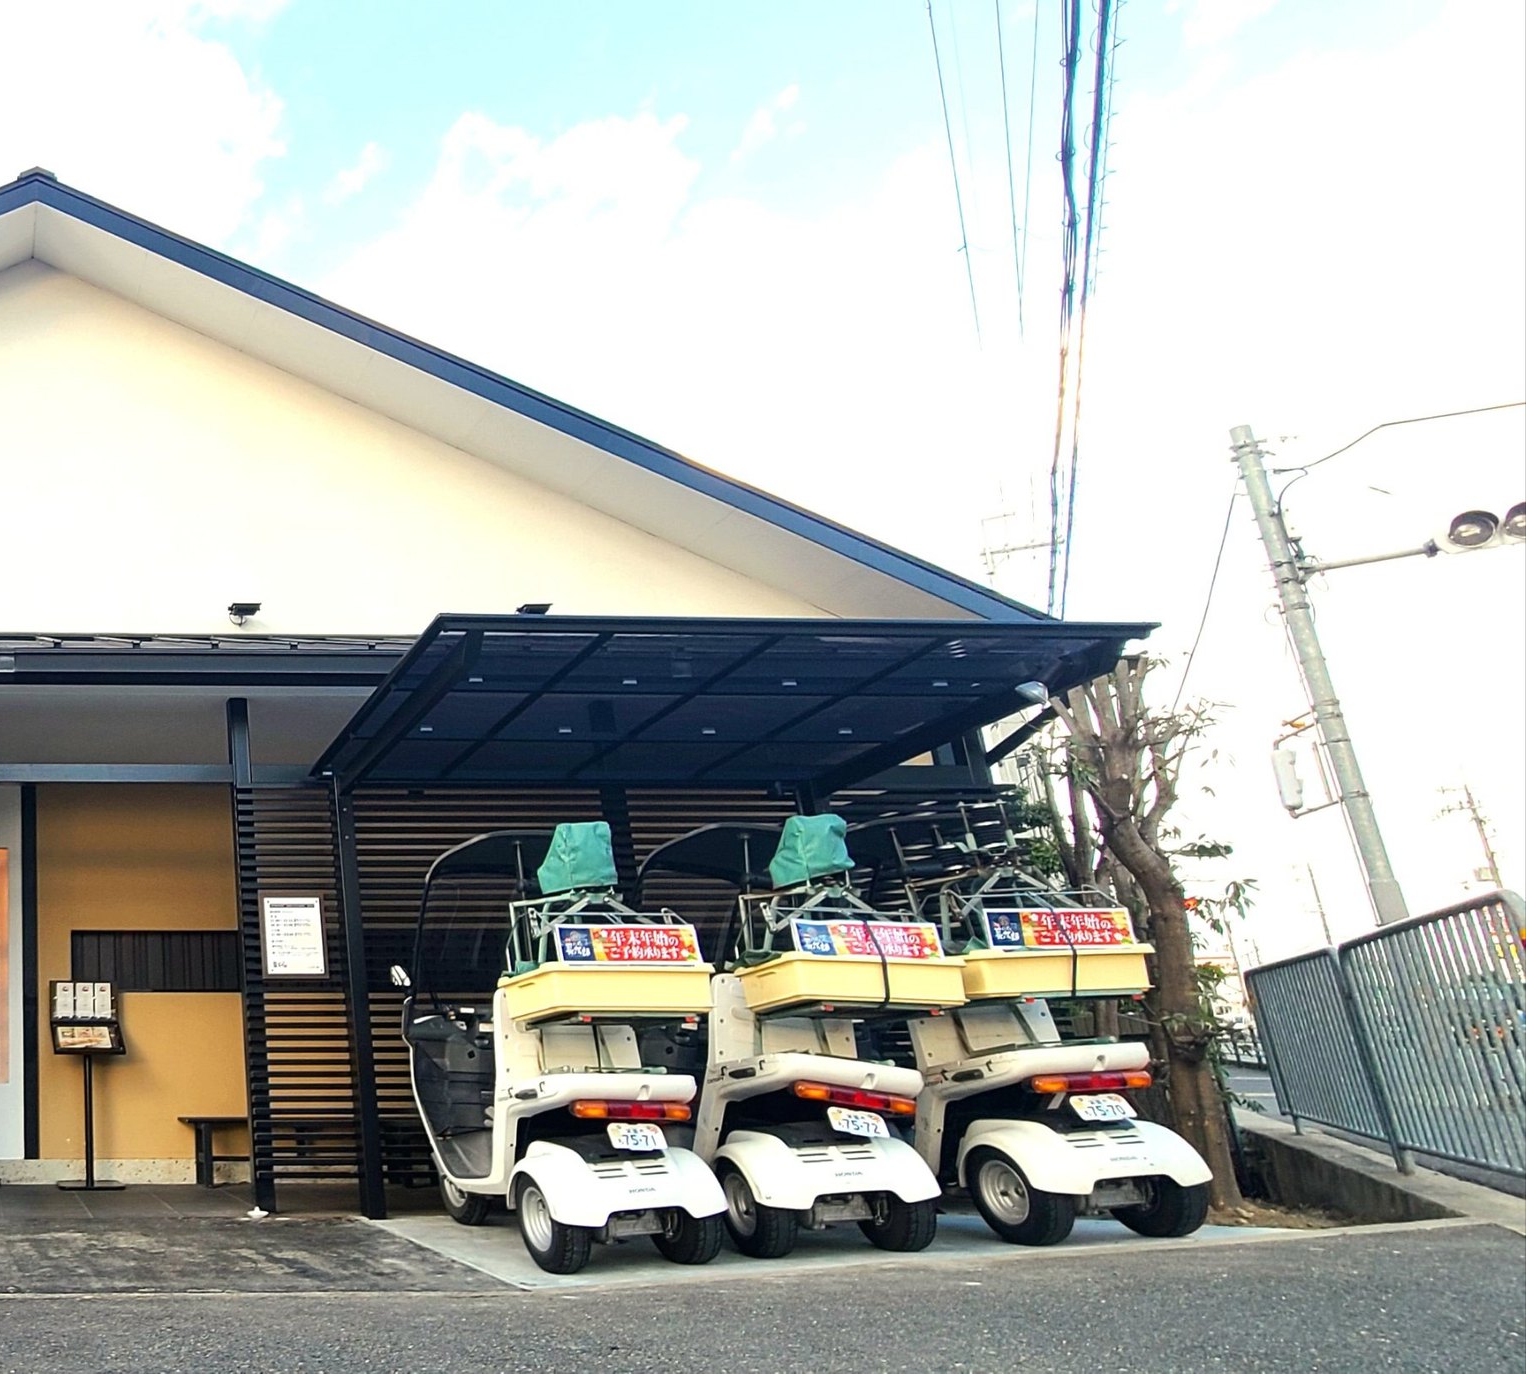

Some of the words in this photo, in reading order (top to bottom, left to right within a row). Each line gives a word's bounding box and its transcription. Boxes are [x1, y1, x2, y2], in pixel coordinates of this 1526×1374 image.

[610, 930, 679, 947] 年末年始の
[1087, 1104, 1126, 1117] 75-70
[842, 1118, 881, 1135] 75-72
[622, 1134, 657, 1147] 75-71
